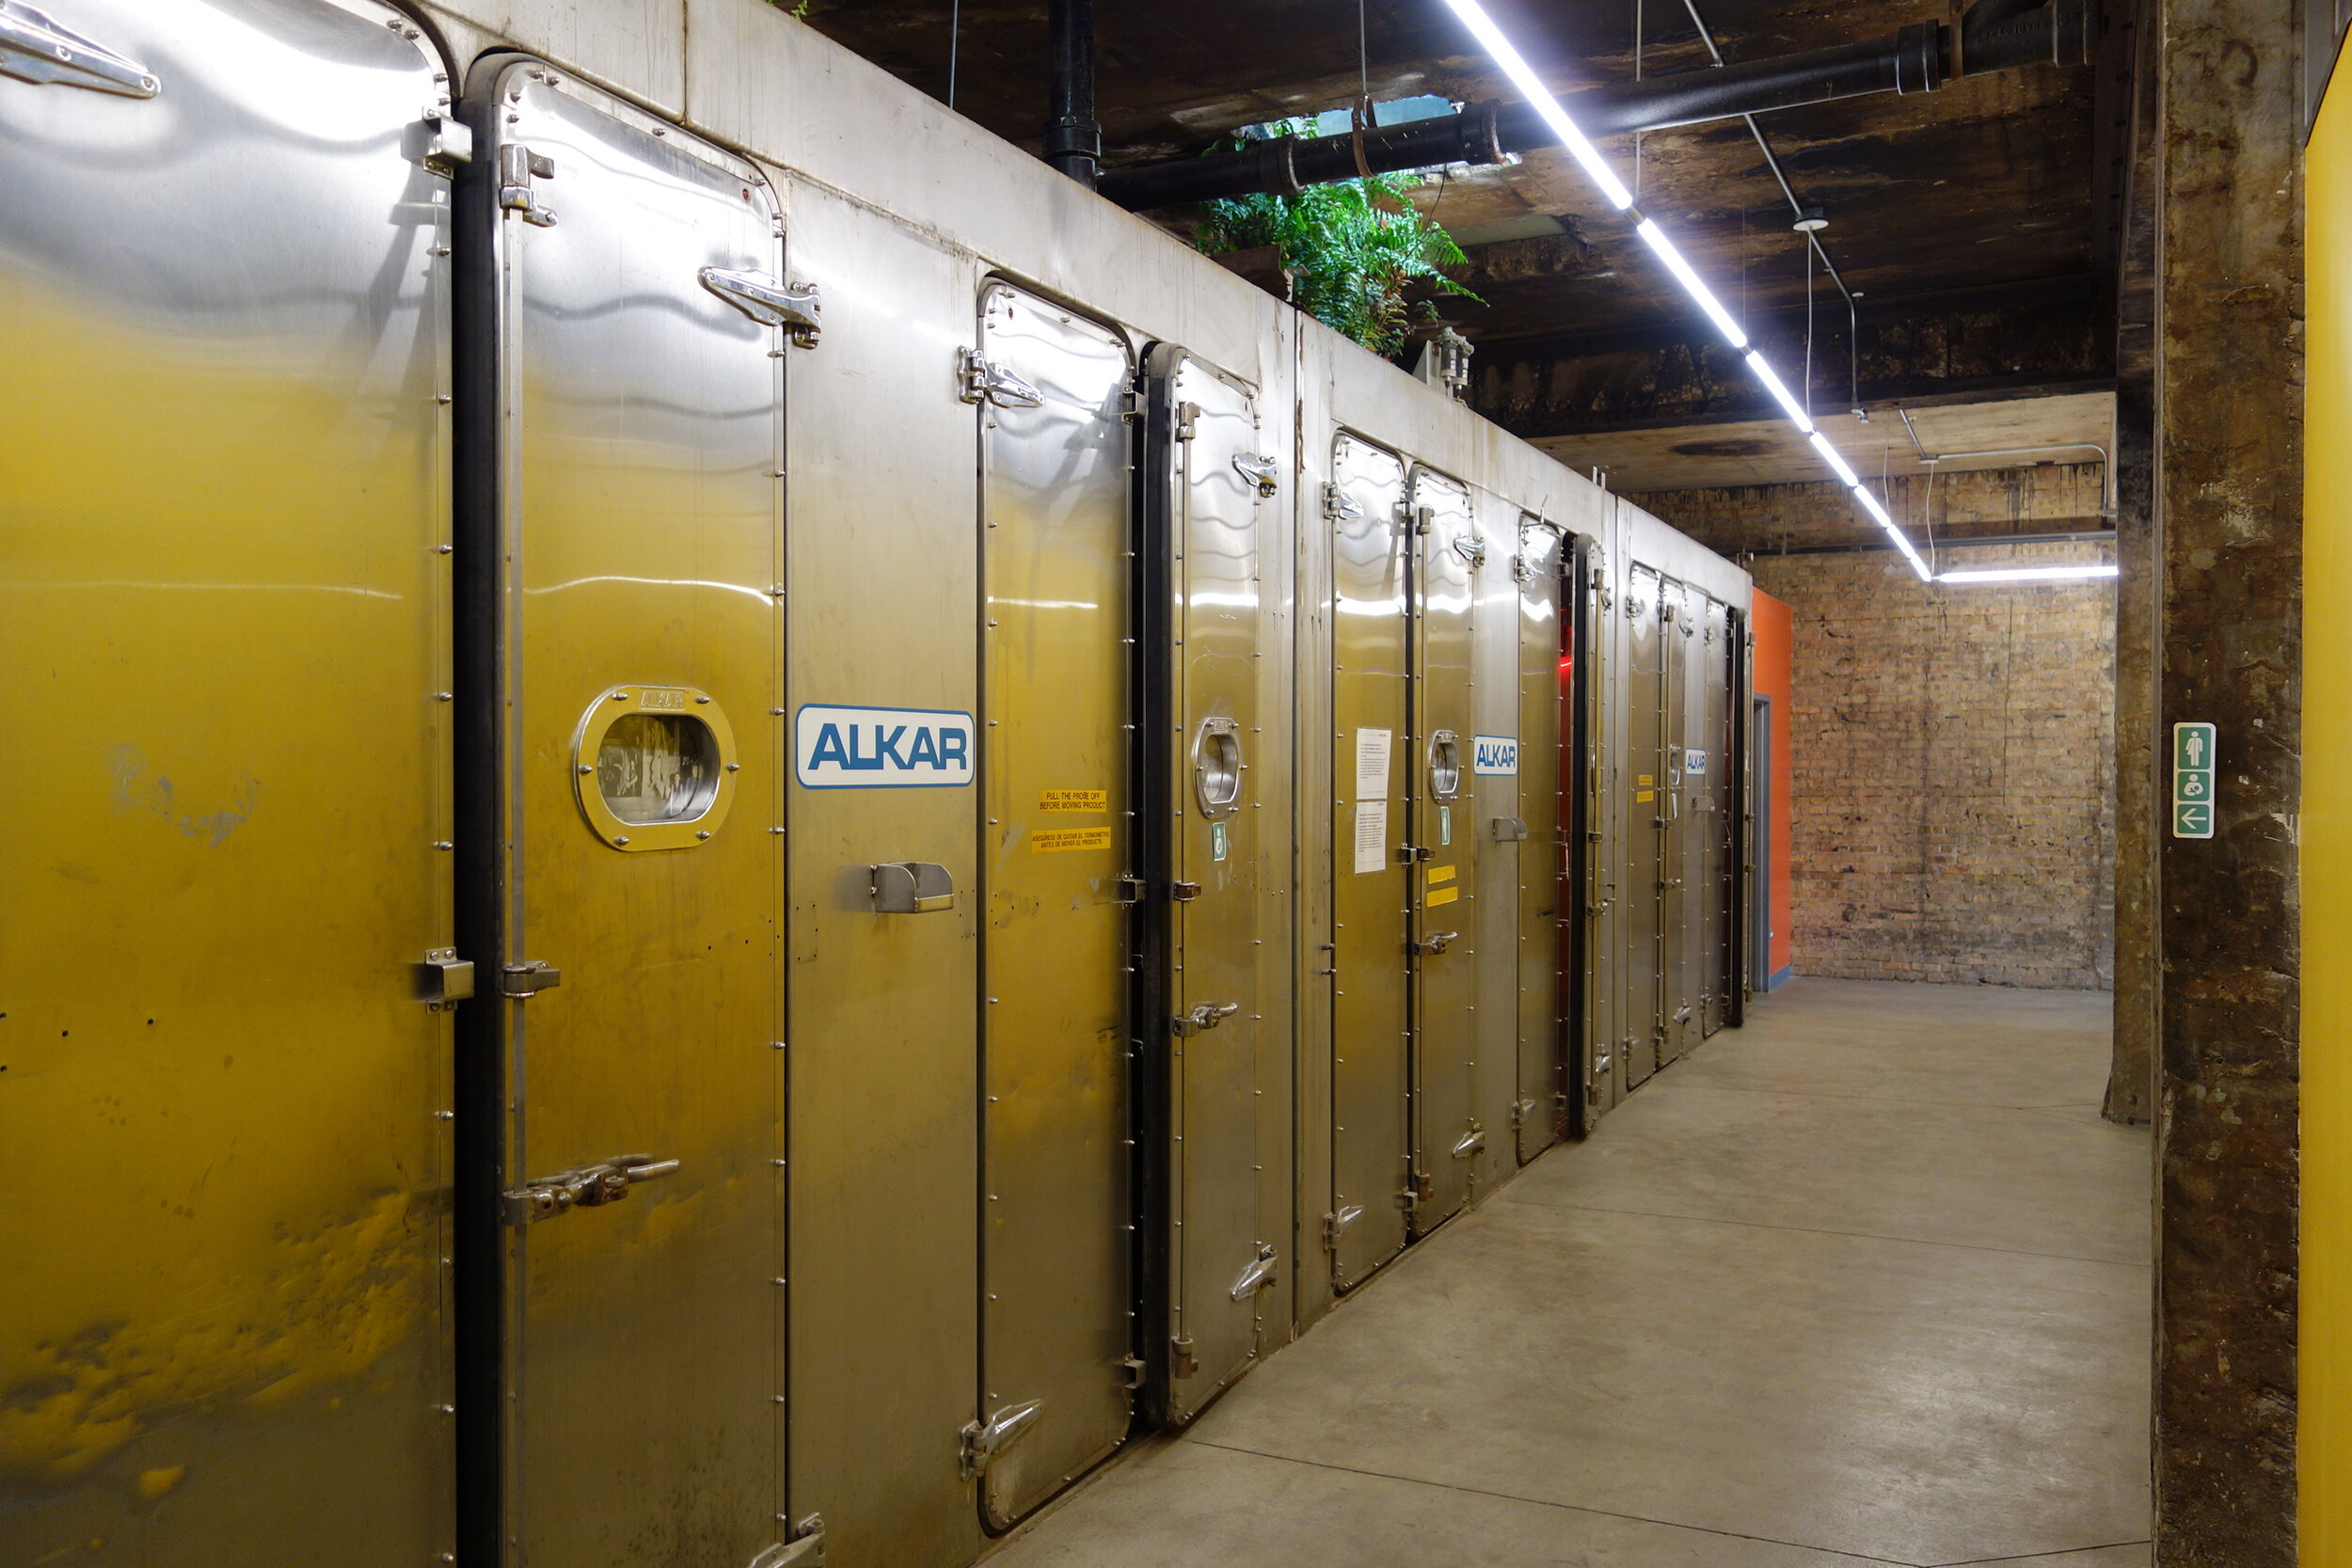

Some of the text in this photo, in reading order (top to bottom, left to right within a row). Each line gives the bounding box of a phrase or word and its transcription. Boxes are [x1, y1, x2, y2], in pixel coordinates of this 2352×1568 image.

[807, 722, 967, 770] ALKAR
[1476, 743, 1516, 768] ALKAR
[1046, 791, 1101, 800] PULL THE PROBE OFF
[1040, 801, 1060, 810] BEFORE
[1061, 801, 1082, 810] MOVING
